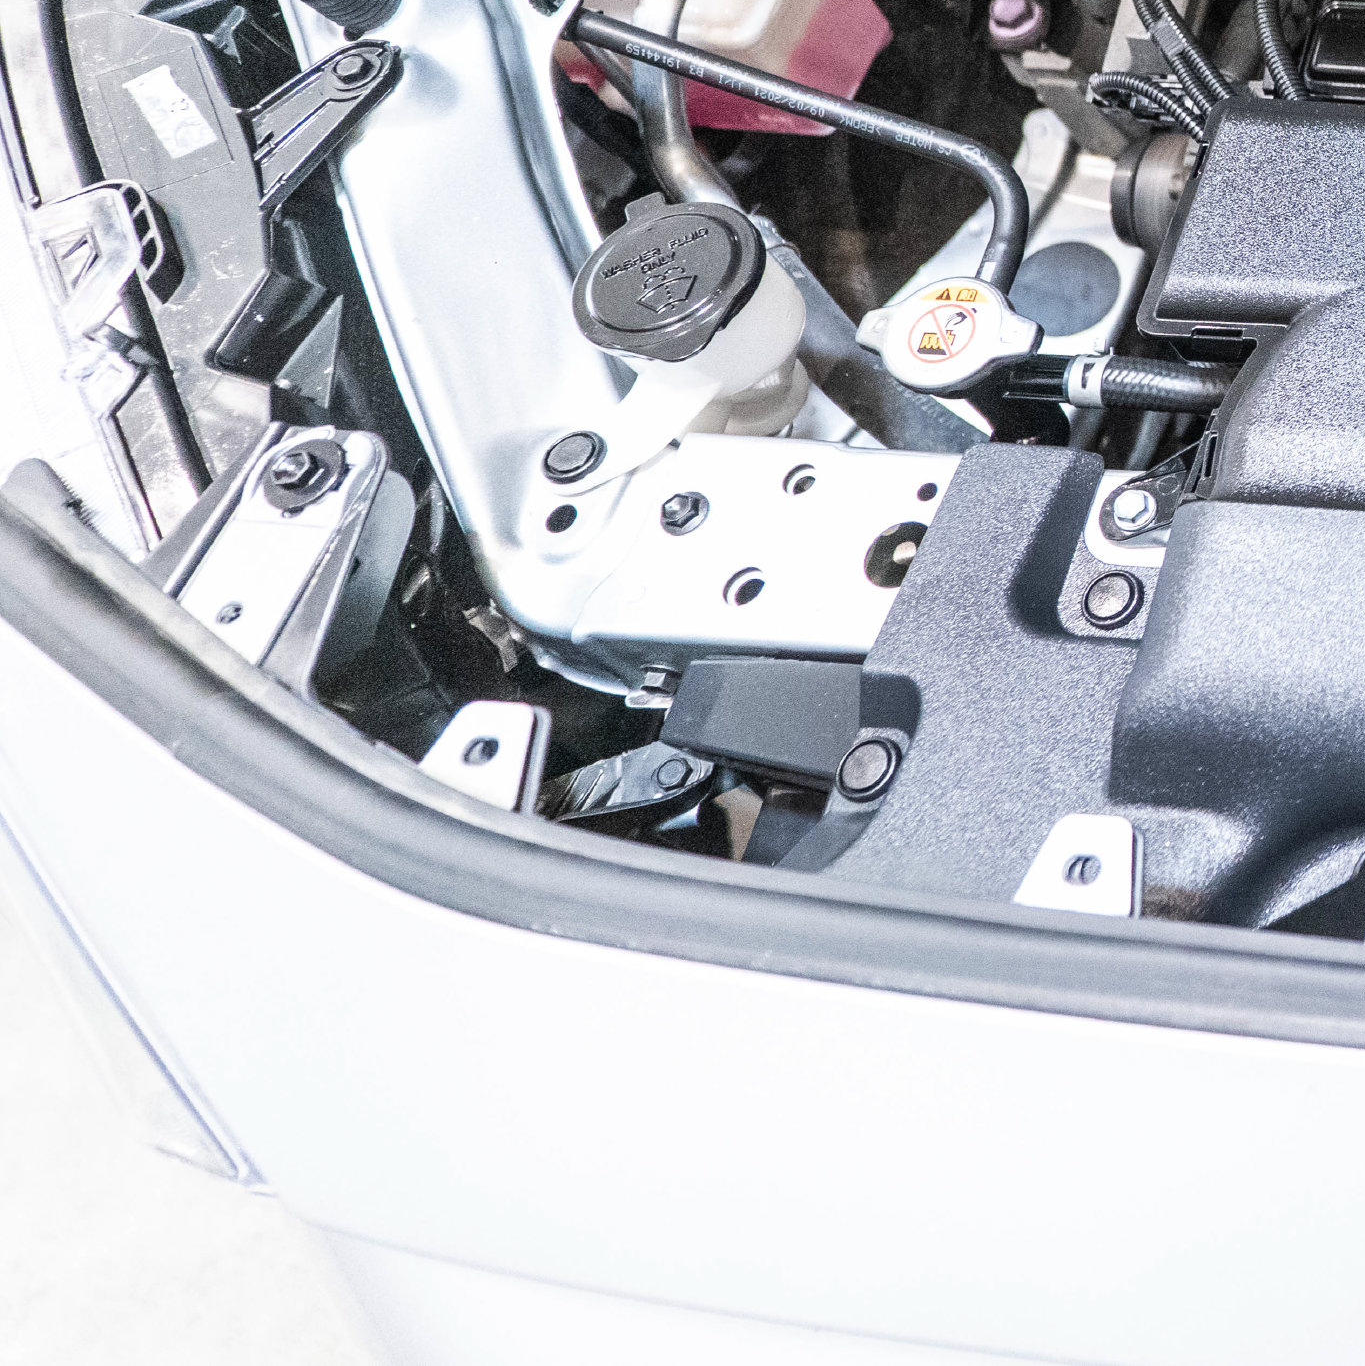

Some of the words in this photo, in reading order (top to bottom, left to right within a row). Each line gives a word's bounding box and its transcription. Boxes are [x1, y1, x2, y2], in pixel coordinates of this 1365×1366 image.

[625, 42, 681, 70] 19:44:59
[688, 64, 705, 78] B3
[754, 86, 826, 118] 09/02/2021
[895, 131, 933, 151] WATER
[601, 247, 662, 280] WASHER
[668, 227, 709, 250] FLUID
[641, 251, 676, 274] ONLY
